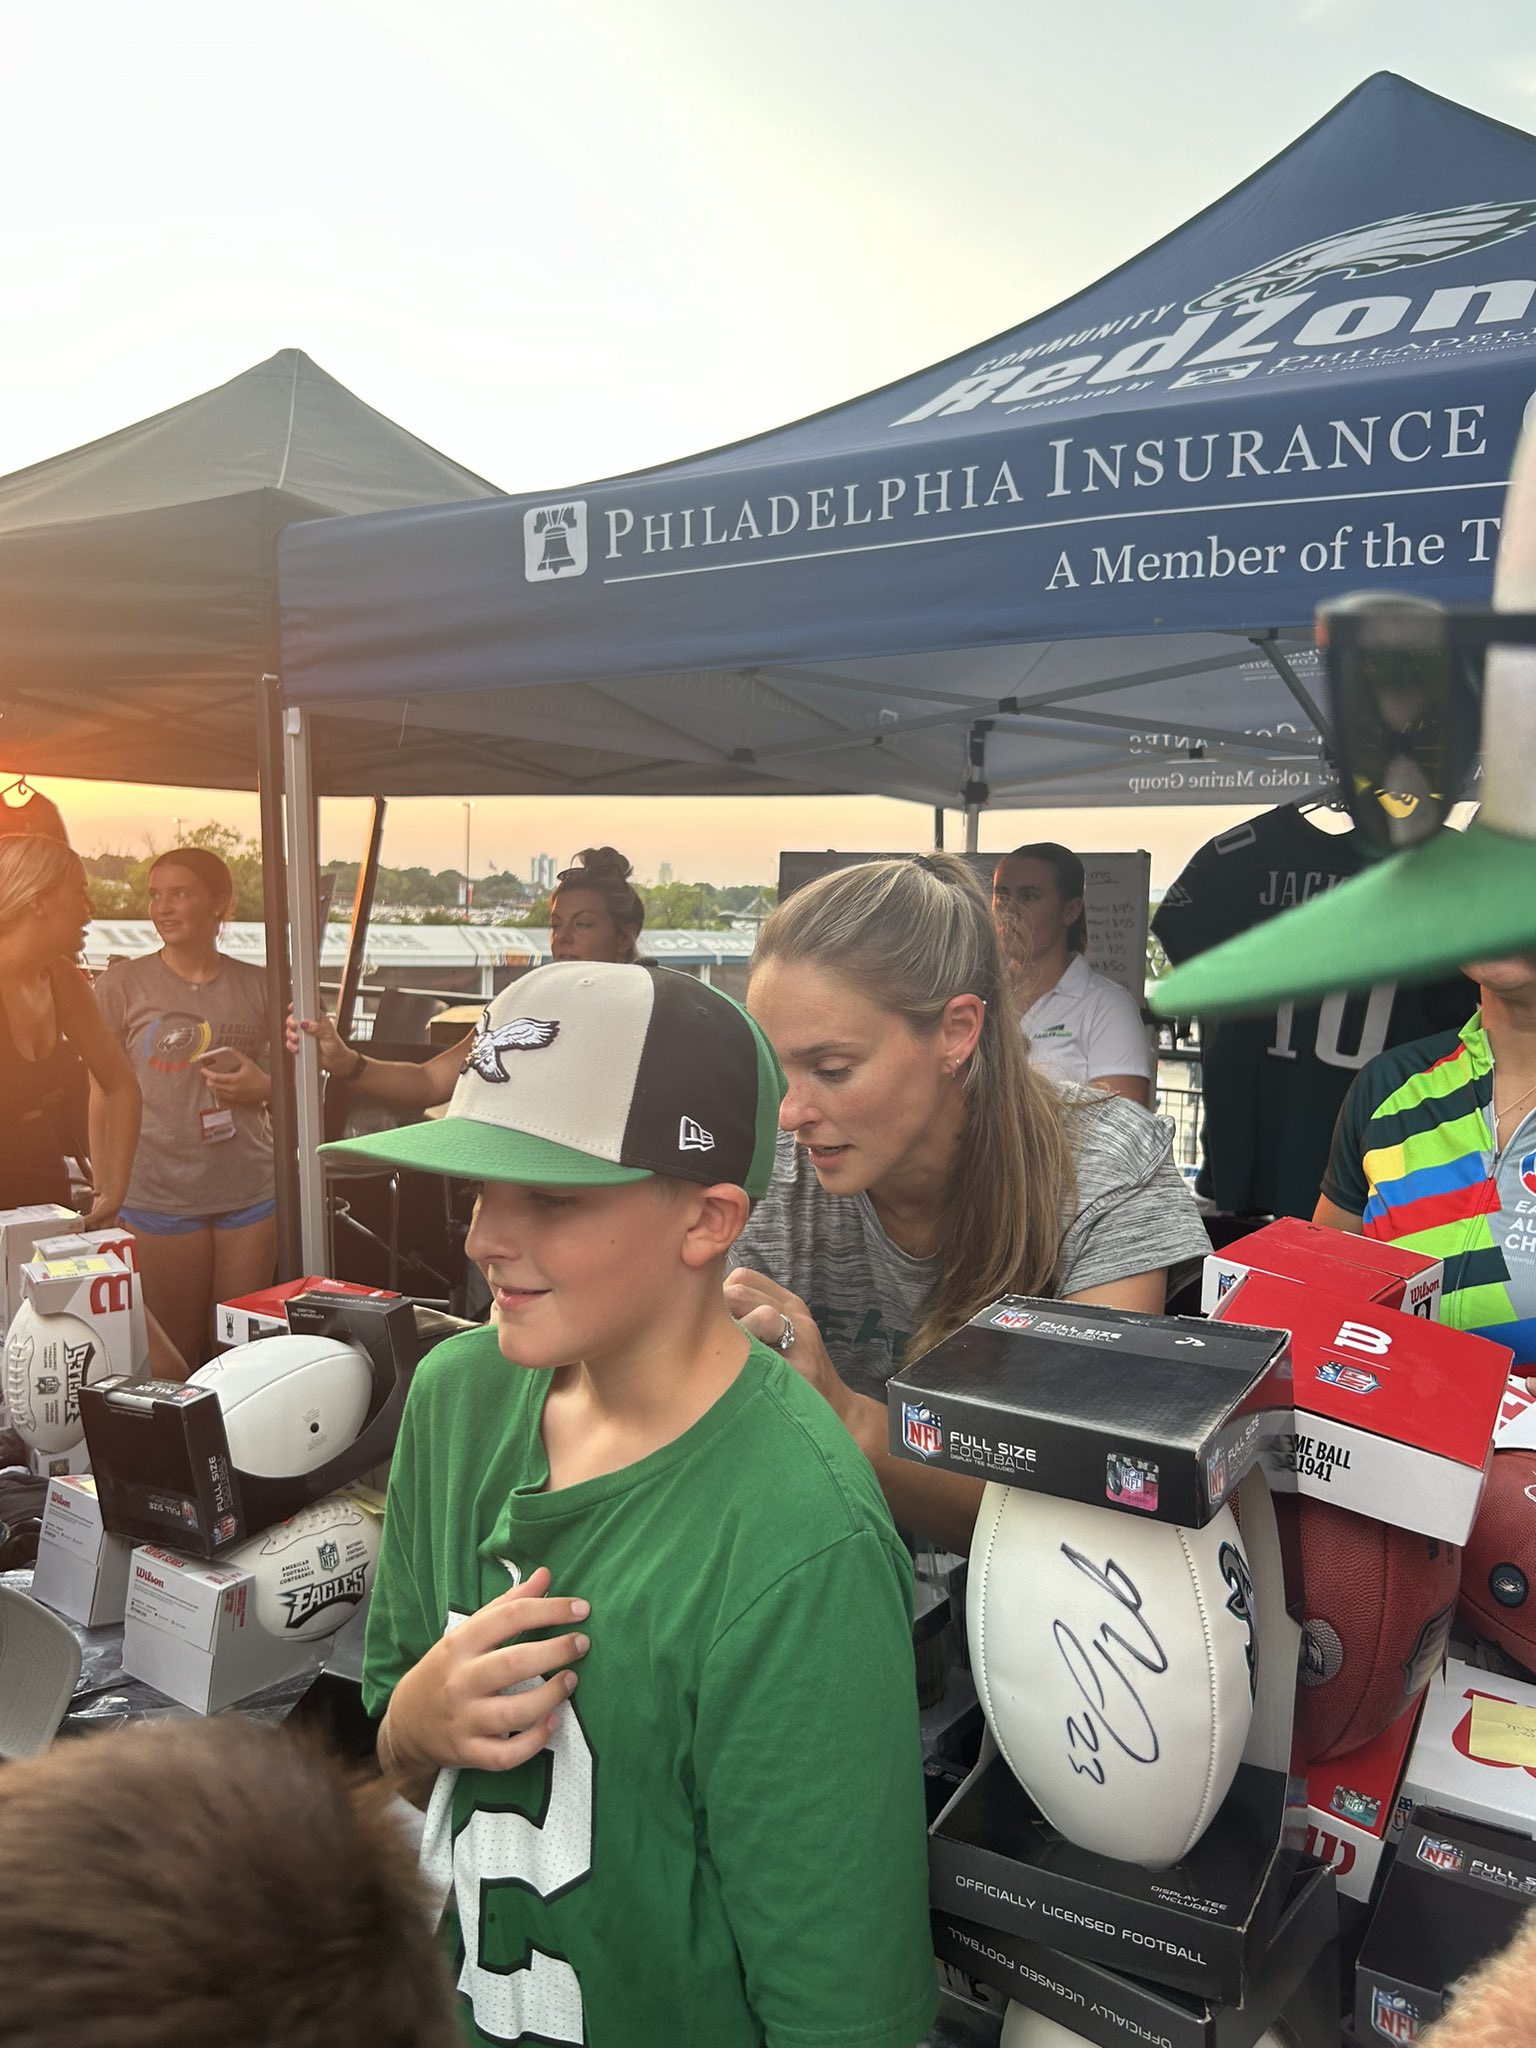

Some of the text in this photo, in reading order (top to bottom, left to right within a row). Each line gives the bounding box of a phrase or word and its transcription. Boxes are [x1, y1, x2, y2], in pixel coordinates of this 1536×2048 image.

[888, 279, 1536, 427] RedZon
[971, 302, 1177, 377] COMMUNITY
[1268, 326, 1536, 369] PHILADEL
[1004, 380, 1155, 415] presented by
[603, 404, 1489, 560] PHILADELPHIA INSURANCE
[1045, 517, 1508, 591] A Member of the T
[1410, 1278, 1440, 1305] Wilson
[1039, 1320, 1078, 1335] FULL
[1084, 1327, 1123, 1340] SIZE
[949, 1431, 1037, 1462] FULL SIZE
[1227, 1413, 1260, 1463] FULL SIZE
[949, 1443, 1035, 1474] FOOTBALL
[1296, 1454, 1333, 1483] 1941
[1315, 1441, 1351, 1470] BALL
[208, 1455, 225, 1513] FULL SIZE
[135, 1565, 165, 1588] Wilson
[280, 1570, 315, 1585] CONFERENCE
[281, 1559, 310, 1572] AMERICAN
[283, 1566, 310, 1578] FOOTBALL
[275, 1560, 371, 1629] EAGLES
[1471, 1859, 1518, 1881] FULL
[1150, 1885, 1229, 1911] DISPLAY TEE
[1158, 1893, 1219, 1915] INCLUDED
[955, 1874, 1208, 1967] OFFICIALLY LICENSED FOOTBALL
[947, 1925, 1015, 1971] FOOTBALL
[1019, 1965, 1087, 2008] LICENSED
[1089, 2003, 1174, 2048] OFFICIALLY
